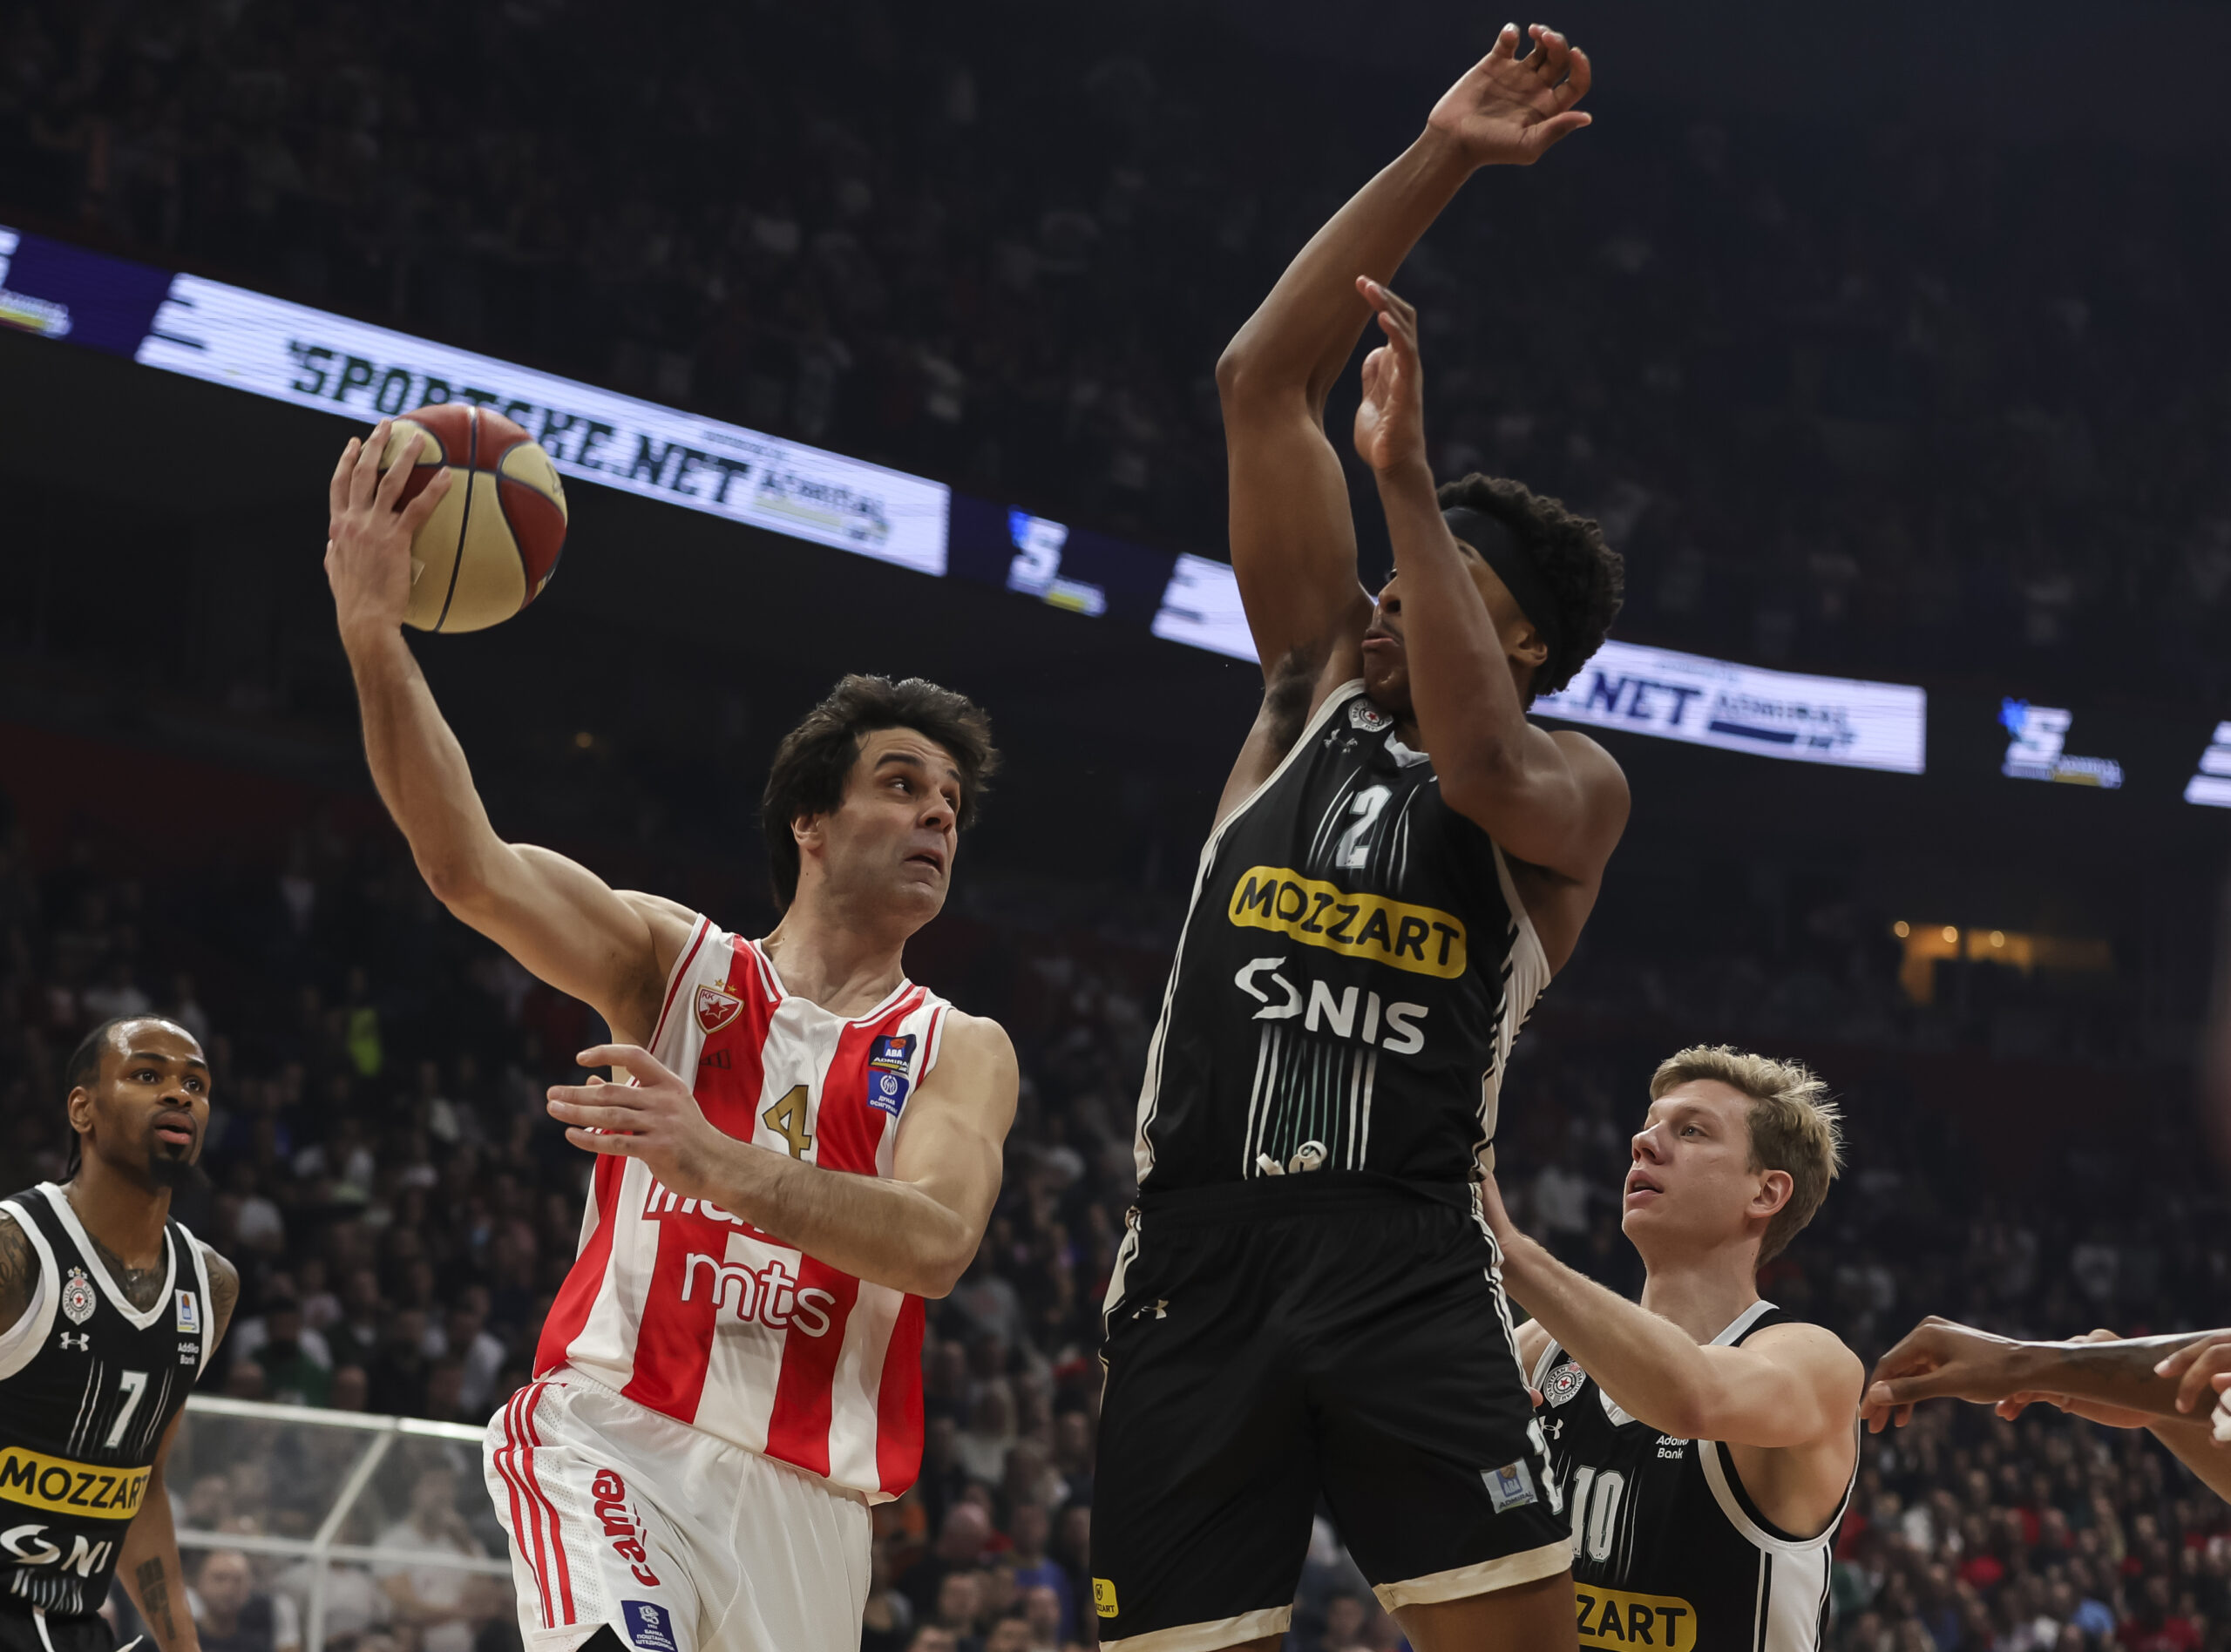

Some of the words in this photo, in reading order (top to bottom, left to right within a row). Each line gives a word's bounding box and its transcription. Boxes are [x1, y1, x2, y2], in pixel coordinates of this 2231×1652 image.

[1336, 785, 1393, 870] 2
[1235, 876, 1460, 966] MOZZART
[885, 1048, 903, 1058] ABA
[763, 1085, 811, 1162] 4
[682, 1253, 837, 1337] mts
[103, 1369, 149, 1450] 7
[1657, 1447, 1684, 1459] Bank
[1570, 1463, 1625, 1562] 10
[1577, 1594, 1688, 1648] ZART
